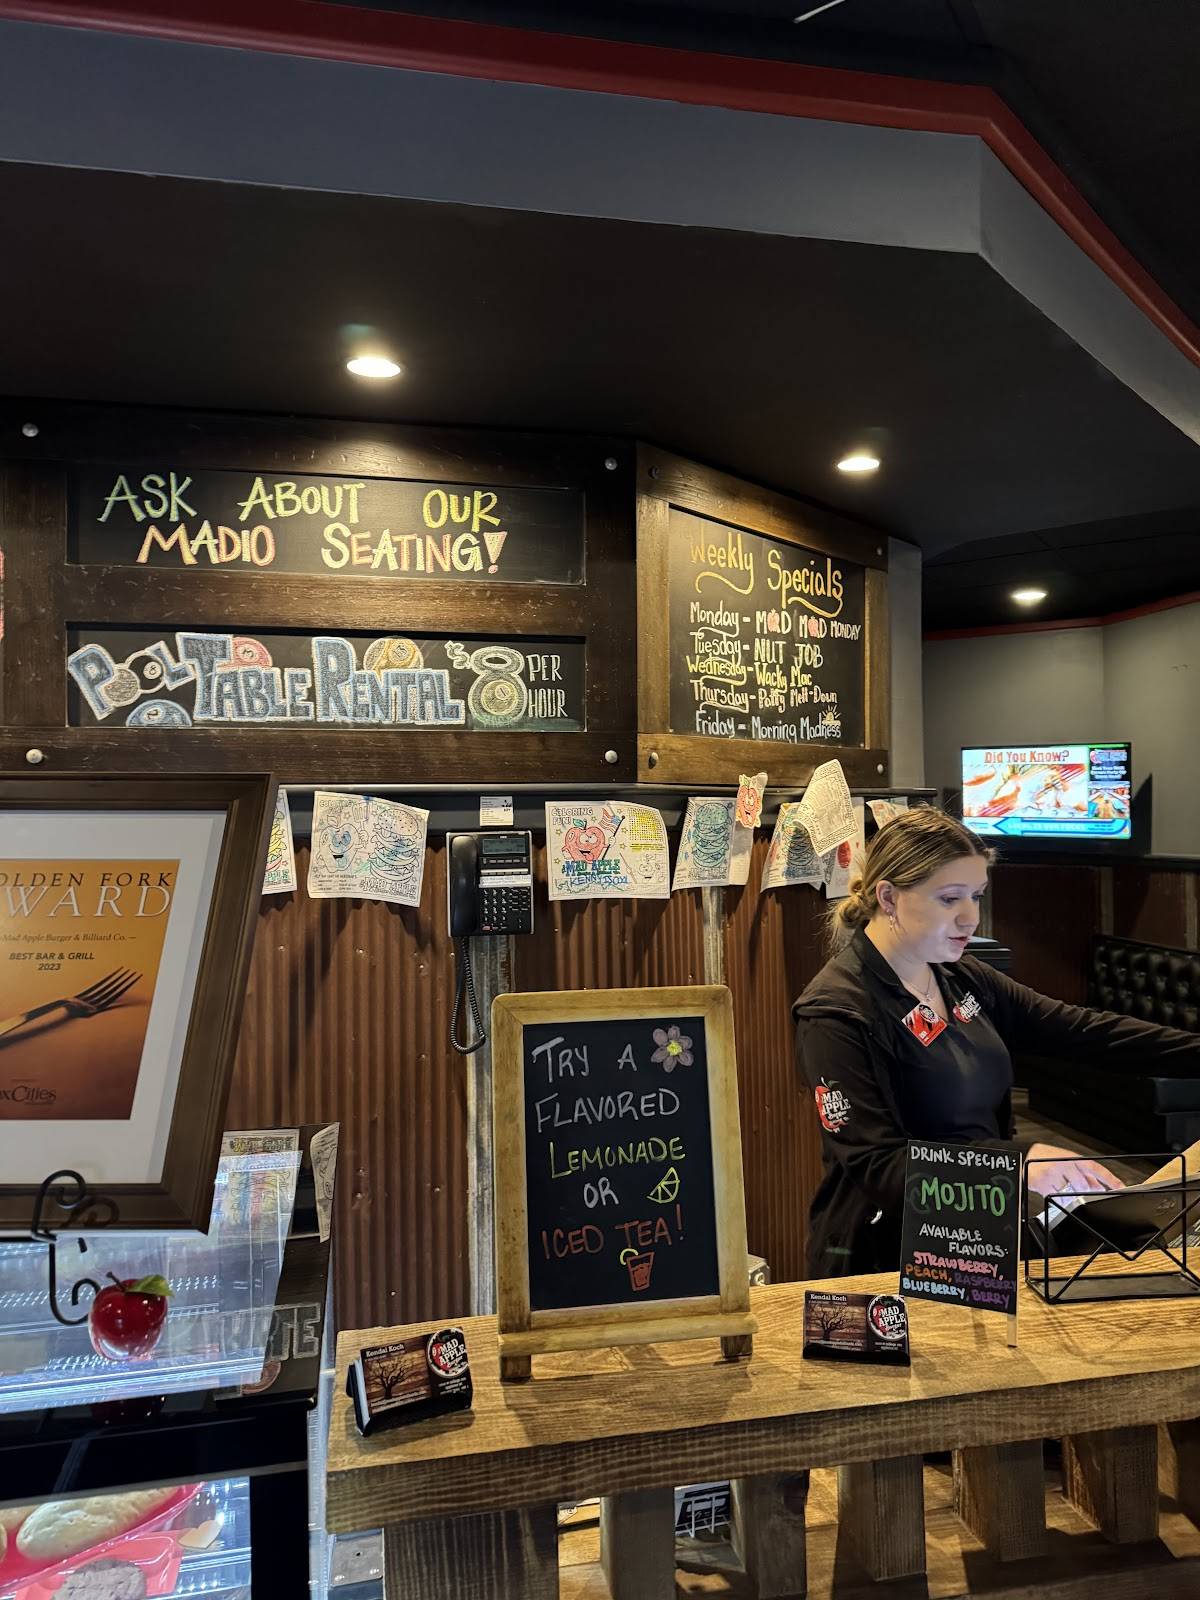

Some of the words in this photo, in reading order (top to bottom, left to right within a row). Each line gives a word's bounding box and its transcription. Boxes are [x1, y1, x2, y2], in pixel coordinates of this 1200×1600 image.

[97, 472, 197, 523] ASK
[238, 476, 366, 524] ABOUT
[423, 489, 500, 533] OUR
[135, 520, 275, 567] MADIO
[321, 522, 508, 574] SEATING!
[690, 530, 754, 590] Weekly
[767, 550, 843, 611] Specials
[690, 600, 739, 635] Monday
[830, 620, 862, 641] MONDAY
[690, 631, 741, 662] Tuesday
[754, 638, 786, 665] NUT
[795, 642, 824, 669] JOB
[175, 632, 315, 723] TABLE
[311, 636, 466, 725] RENTAL
[525, 654, 563, 682] PER
[686, 655, 747, 685] Wednesday
[754, 661, 787, 693] Wacky
[790, 666, 812, 687] Mac
[528, 688, 569, 719] HOUR
[690, 679, 749, 713] Thursday
[758, 688, 786, 713] Patty
[695, 710, 735, 739] Friday
[751, 715, 797, 744] Morning
[800, 712, 842, 741] Madness
[984, 751, 1003, 763] Did
[1006, 751, 1026, 763] You
[1029, 750, 1070, 763] Know?
[100, 872, 174, 887] FORK
[22, 934, 45, 944] Apple
[46, 934, 72, 943] Burger
[82, 933, 112, 941] Billiard
[113, 933, 127, 941] Co.
[9, 952, 33, 961] BEST
[35, 952, 56, 961] BAR
[57, 952, 64, 960] &
[68, 952, 95, 960] GRILL
[38, 963, 61, 971] 2023
[531, 1036, 590, 1083] TRY
[617, 1043, 637, 1071] A
[534, 1087, 680, 1133] FLAVORED
[821, 1090, 843, 1103] MAD
[550, 1136, 685, 1179] LEMONADE
[910, 1146, 954, 1163] DRINK
[957, 1151, 1017, 1171] SPECIAL:
[584, 1176, 619, 1209] OR
[920, 1176, 1006, 1217] MOJITO
[541, 1224, 604, 1260] ICED
[614, 1203, 685, 1249] TEA!
[919, 1223, 983, 1242] AVAILABLE
[949, 1242, 1009, 1258] FLAVORS:
[954, 1274, 1015, 1292] RASPBERRY
[879, 1305, 900, 1317] MAD
[972, 1289, 1010, 1309] BERRY
[879, 1313, 906, 1328] APPLE
[365, 1347, 388, 1358] Kendal
[388, 1343, 405, 1353] Koch
[439, 1344, 466, 1366] APPLE
[440, 1338, 459, 1355] MAD
